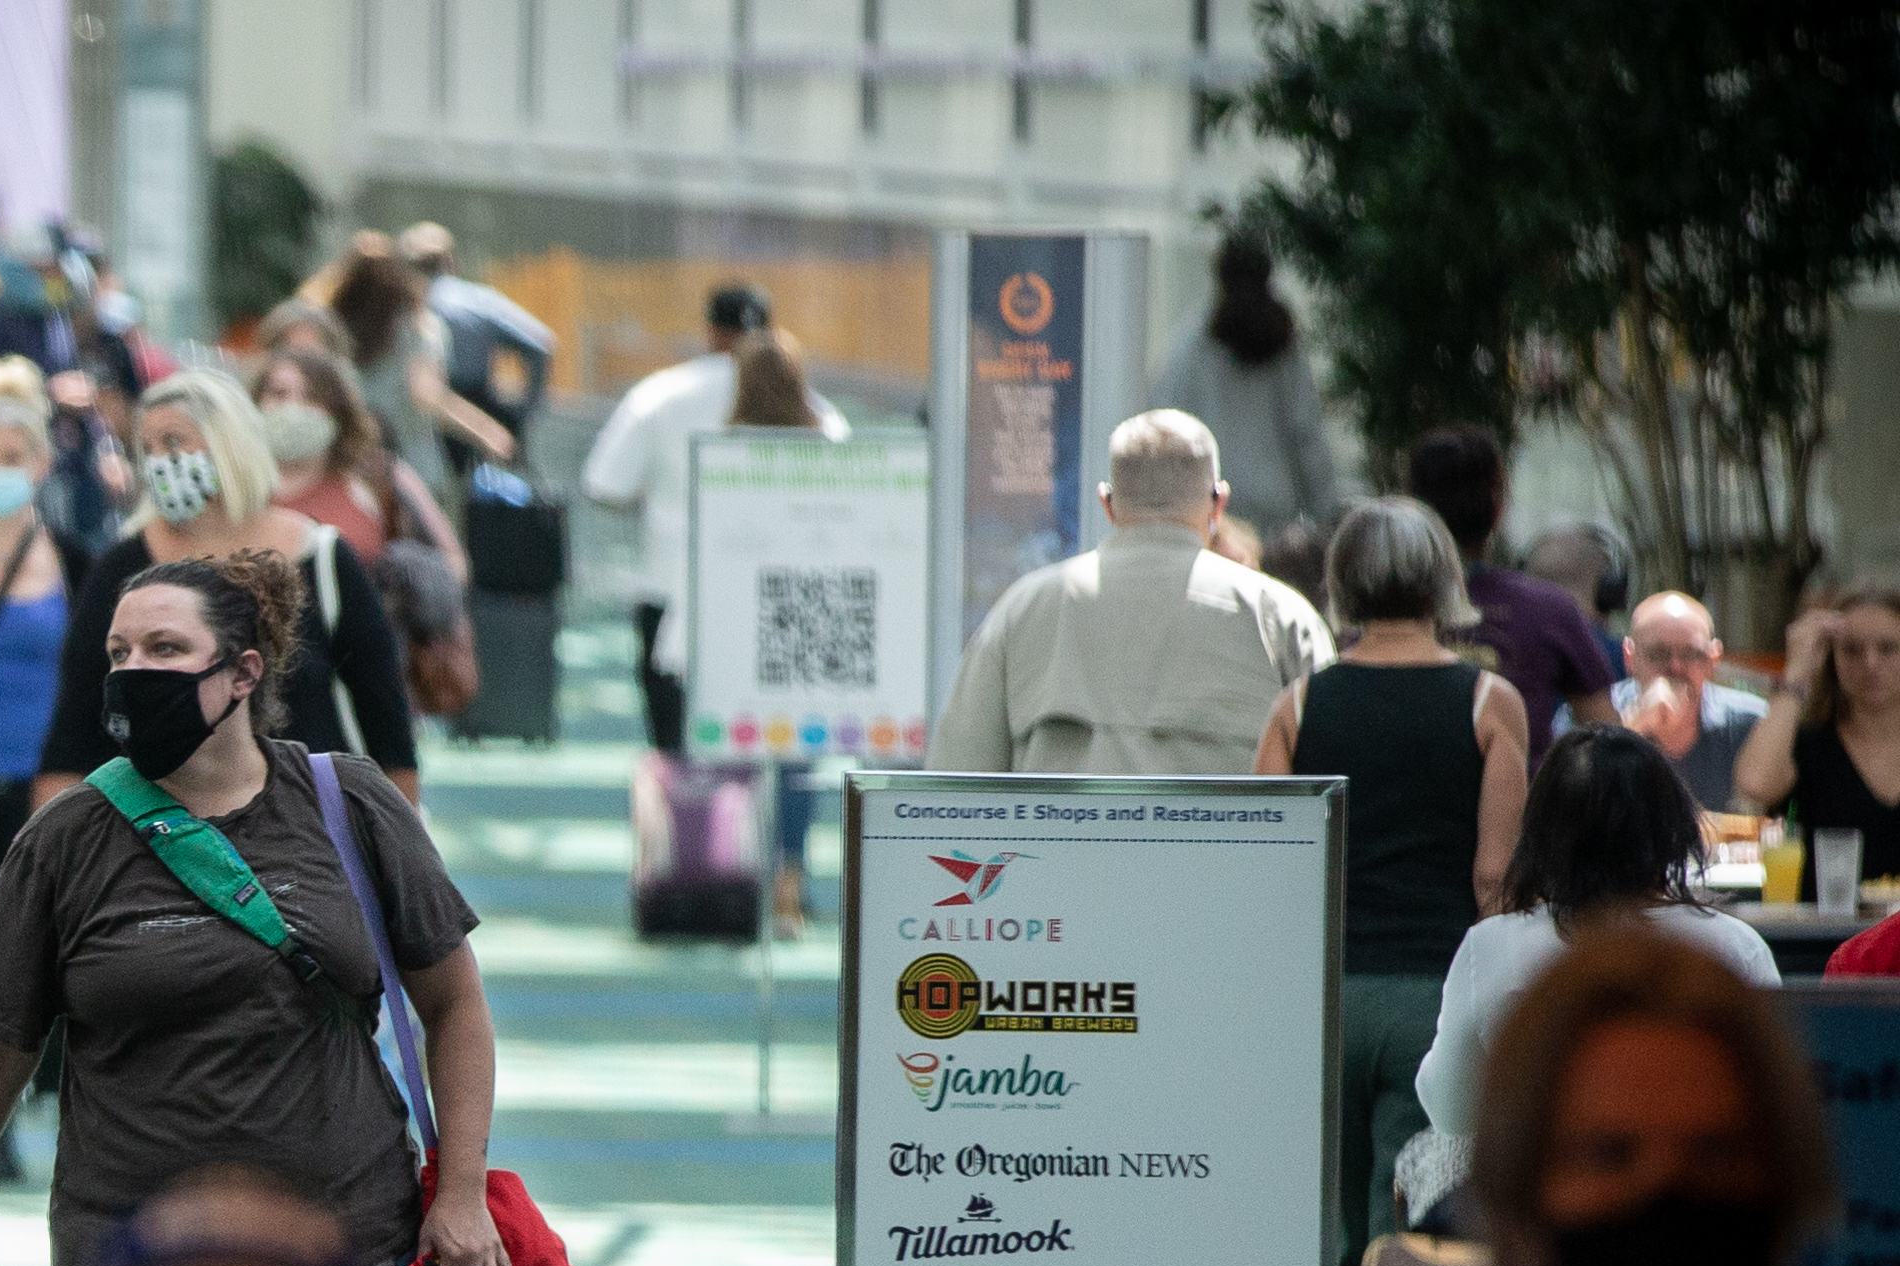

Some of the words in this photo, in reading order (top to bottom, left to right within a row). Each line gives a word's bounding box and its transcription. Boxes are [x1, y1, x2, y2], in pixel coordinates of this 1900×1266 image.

[894, 803, 1008, 821] Concourse
[1014, 804, 1026, 820] E
[1033, 804, 1099, 824] Shops
[1105, 805, 1145, 821] and
[1153, 805, 1284, 823] Restaurants
[898, 917, 1063, 942] CALLIOPE
[898, 981, 1136, 1013] HOPWORKS
[1051, 1017, 1135, 1031] BREWERY
[925, 1054, 1081, 1112] jamba
[888, 1142, 946, 1183] The
[955, 1143, 1110, 1183] Oregonian
[1118, 1153, 1210, 1179] NEWS
[888, 1219, 1072, 1261] Tillamook
